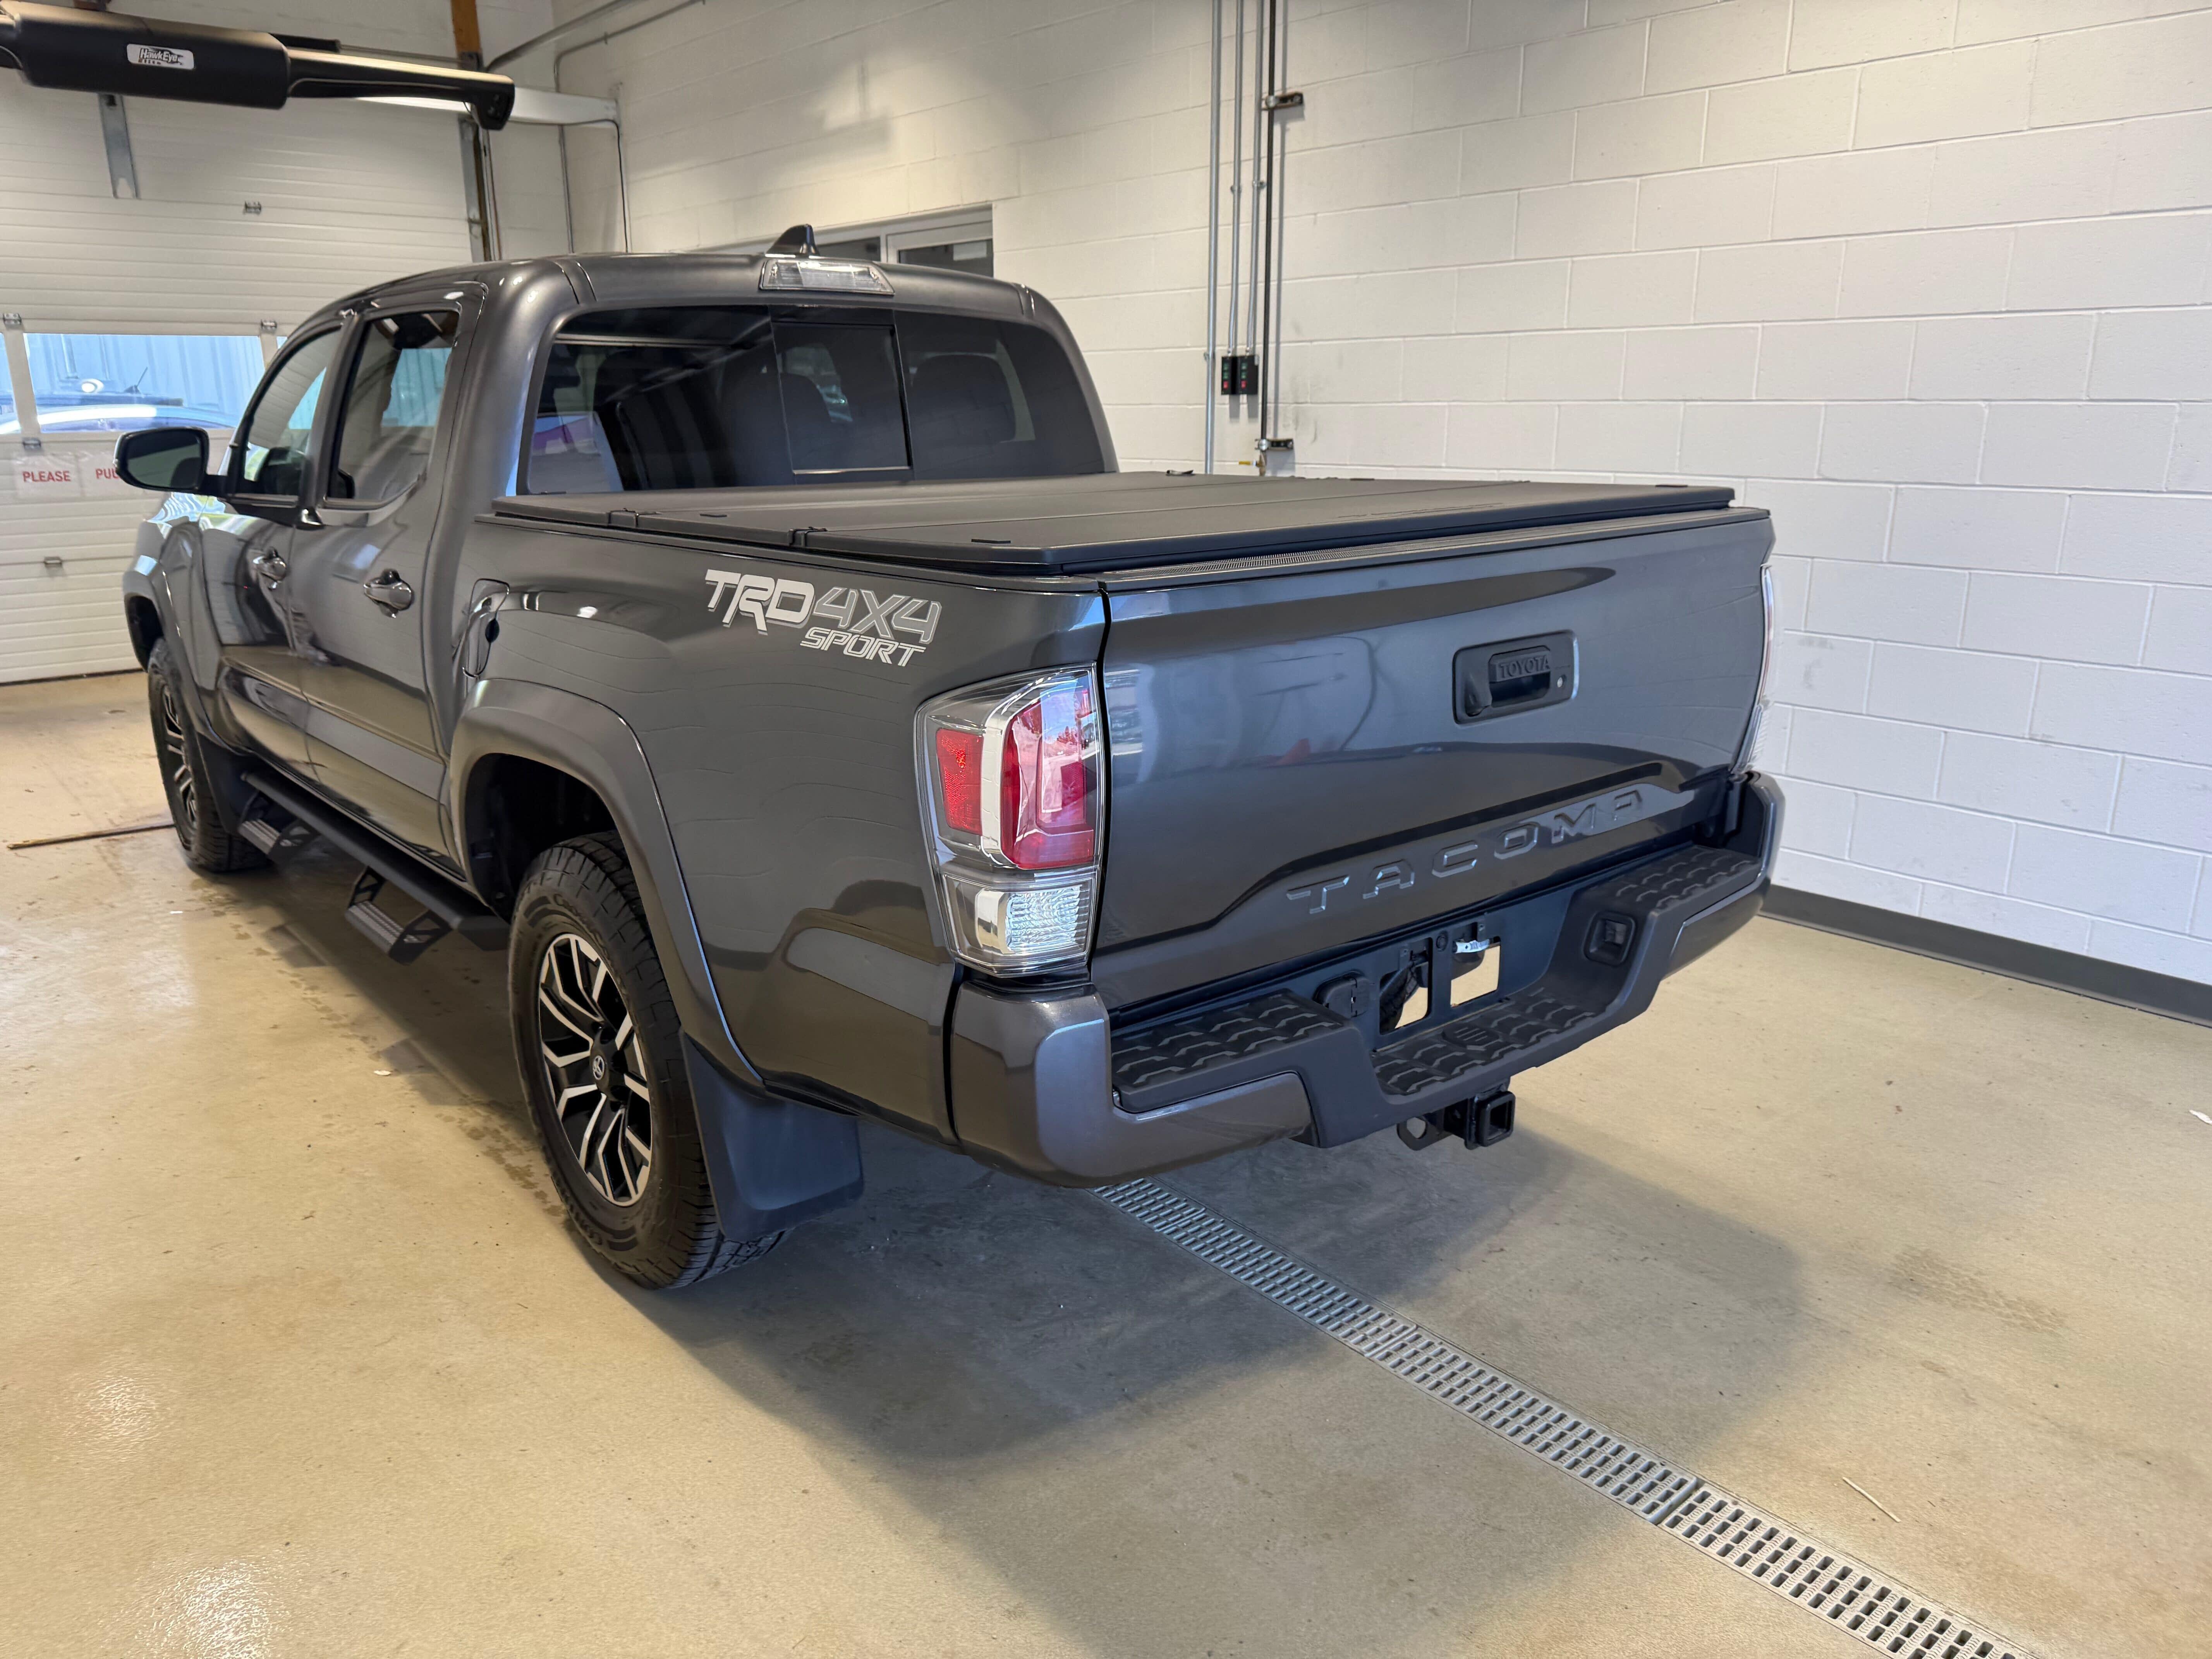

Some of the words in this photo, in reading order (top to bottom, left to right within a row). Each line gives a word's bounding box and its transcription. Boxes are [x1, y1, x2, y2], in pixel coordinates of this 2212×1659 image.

[139, 48, 179, 63] HawkEye
[22, 471, 71, 482] PLEASE
[95, 467, 120, 479] PUL
[705, 569, 816, 635] TRD
[800, 627, 926, 667] SPORT
[1500, 654, 1550, 678] TOYOTA
[1286, 788, 1643, 914] TACOMA
